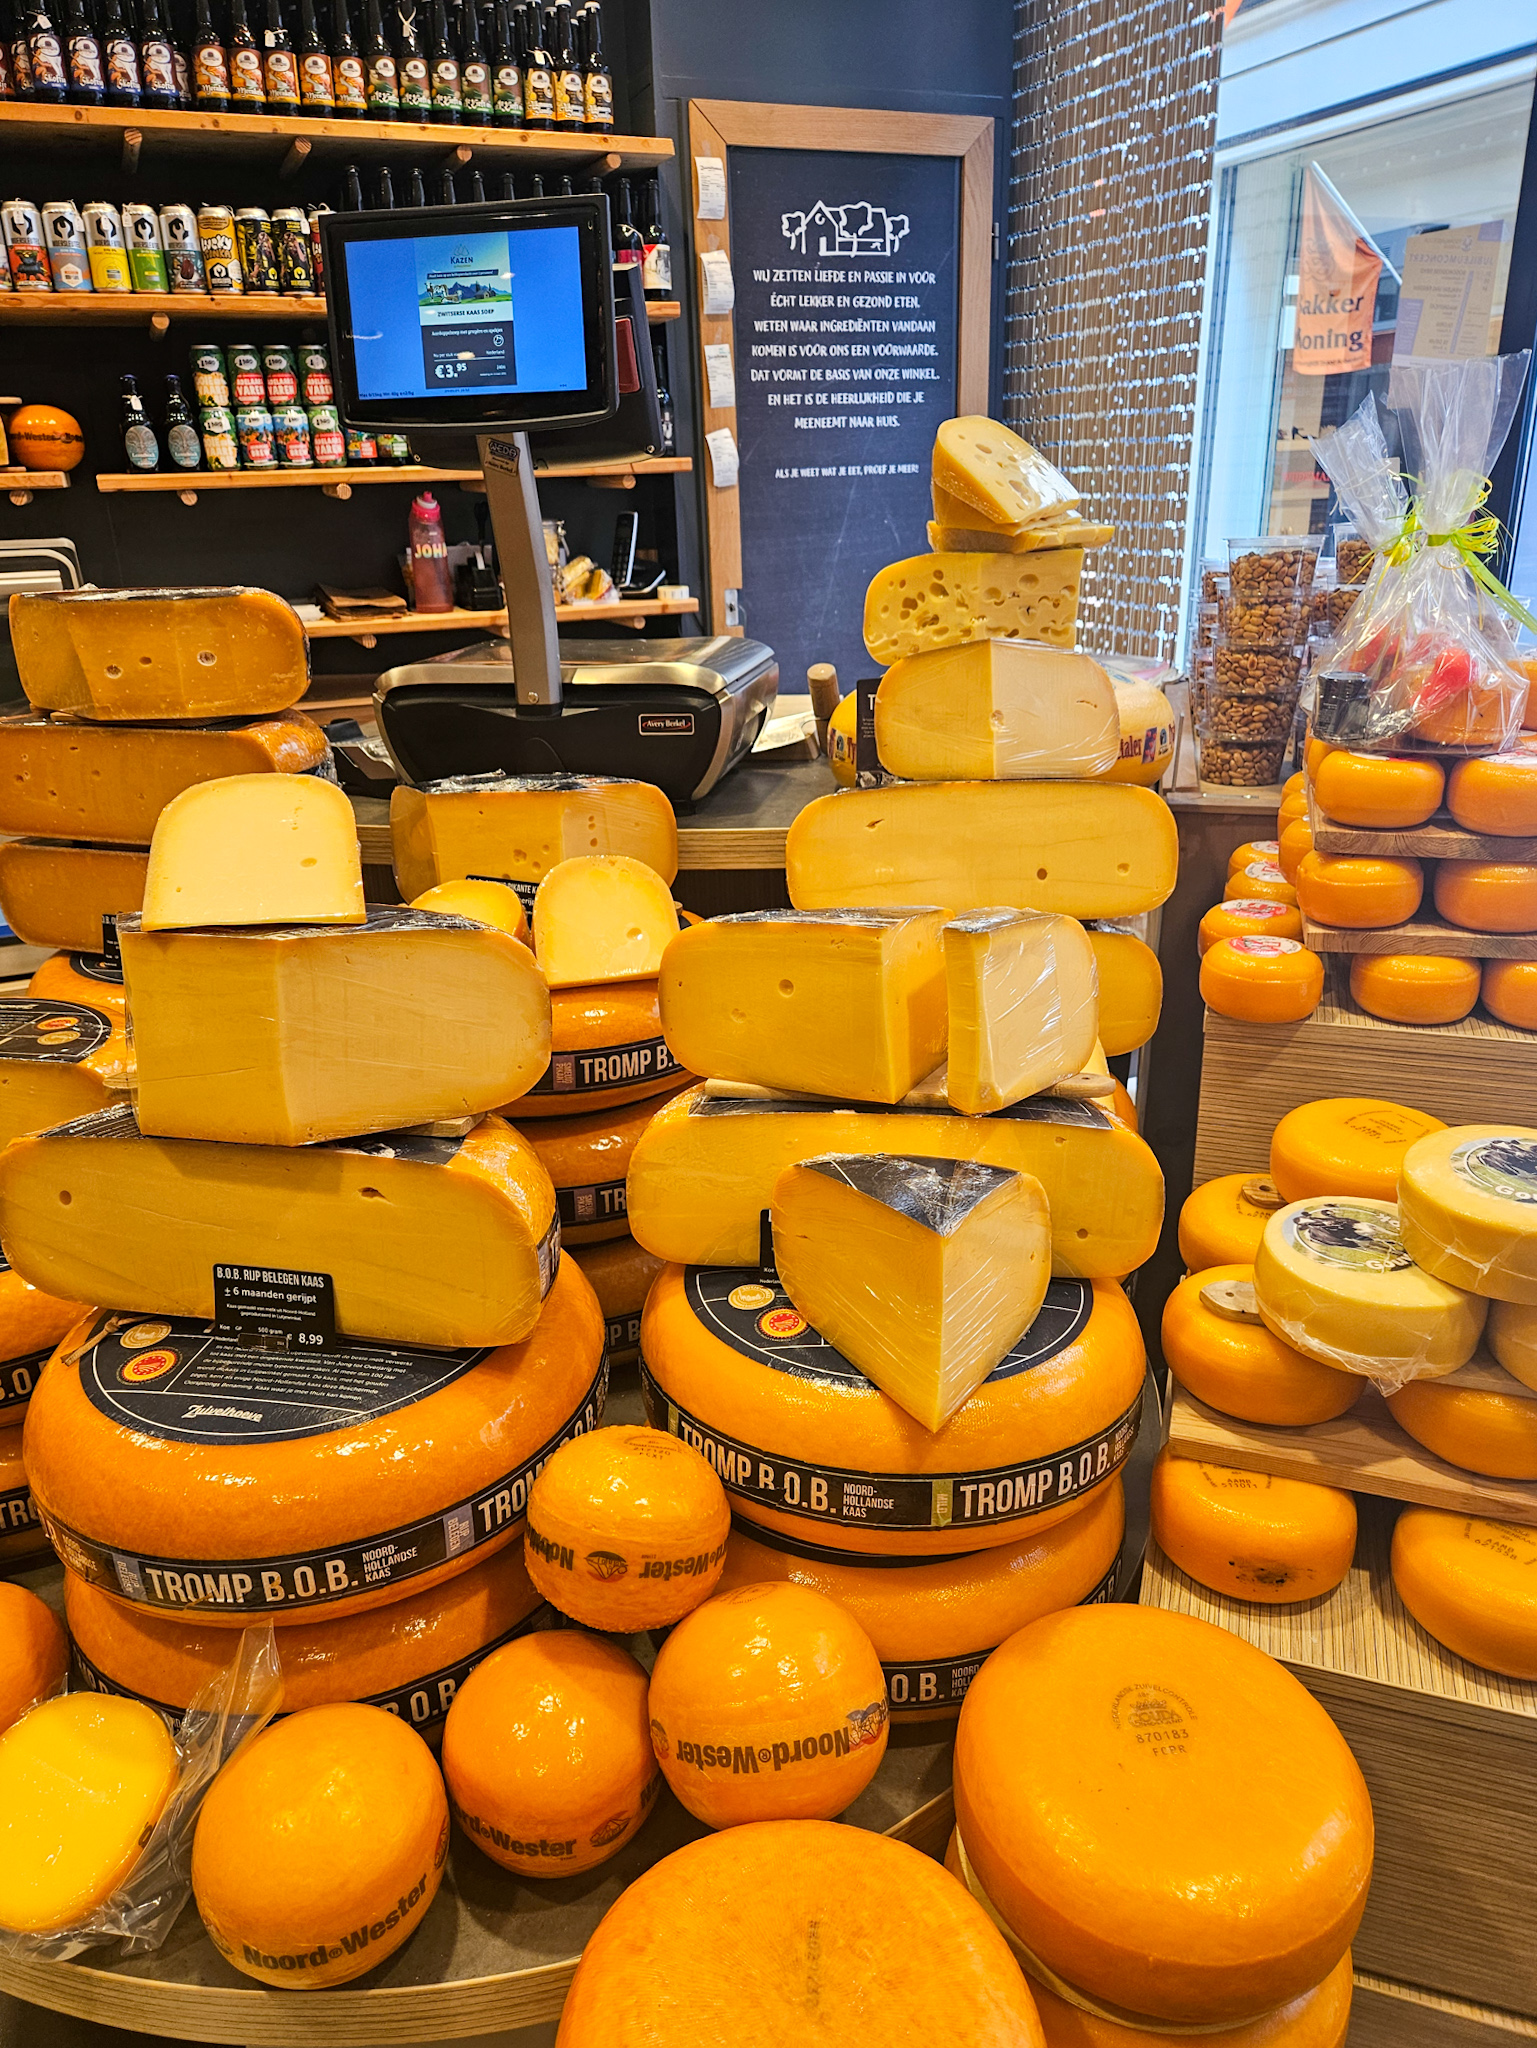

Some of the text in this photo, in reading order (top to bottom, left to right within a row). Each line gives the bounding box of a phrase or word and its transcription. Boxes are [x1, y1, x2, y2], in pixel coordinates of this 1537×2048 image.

[450, 256, 474, 264] KAZEN
[753, 269, 935, 283] WIJ ZETTEN LIEFDE EN PASSIE IN VOOR
[771, 292, 920, 308] ÉCHT LEKKER EN GEZOND ETEN.
[1298, 295, 1364, 315] akker
[754, 318, 935, 332] WETEN WAAR INGREDIËNTEN VANDAAN
[752, 344, 938, 356] KOMEN IS VOOR ONS EEN VOORWAARDE.
[751, 369, 939, 381] DAT VORMT DE BASIS VAN ONZE WINKEL.
[769, 392, 923, 405] EN HET IS DE HEERLIJKHEID DIE JE
[795, 416, 899, 428] MEENEEMT NAAR HUIS.
[775, 464, 918, 478] ALS JE WEET WAT JE EET, PROEF JE MEER!
[647, 719, 686, 728] Avery Berkel
[1117, 735, 1142, 760] taler
[580, 1049, 651, 1084] TROMP
[216, 1266, 324, 1288] B.O.B. RIJP BELEGEN KAAS
[232, 1286, 240, 1296] 6
[241, 1288, 284, 1300] maanden
[286, 1292, 318, 1304] gerijpt
[298, 1333, 324, 1346] 8,99
[182, 1404, 264, 1423] Zuivelhoeve
[681, 1422, 752, 1486] TROMP
[960, 1442, 1111, 1518] TROMP B.O.B.
[843, 1482, 878, 1498] NOORD-
[843, 1494, 894, 1510] HOLLANDSE
[936, 1493, 948, 1514] MILD
[843, 1506, 867, 1518] KAAS
[448, 1516, 460, 1552] BELEGEN
[362, 1544, 398, 1564] NOORD-
[364, 1546, 418, 1574] HOLLANDSE
[146, 1558, 359, 1604] TROMP B.O.B.
[365, 1567, 392, 1584] KAAS
[1134, 1683, 1198, 1720] ZUIVELCONTROLE
[1136, 1728, 1189, 1744] 870183
